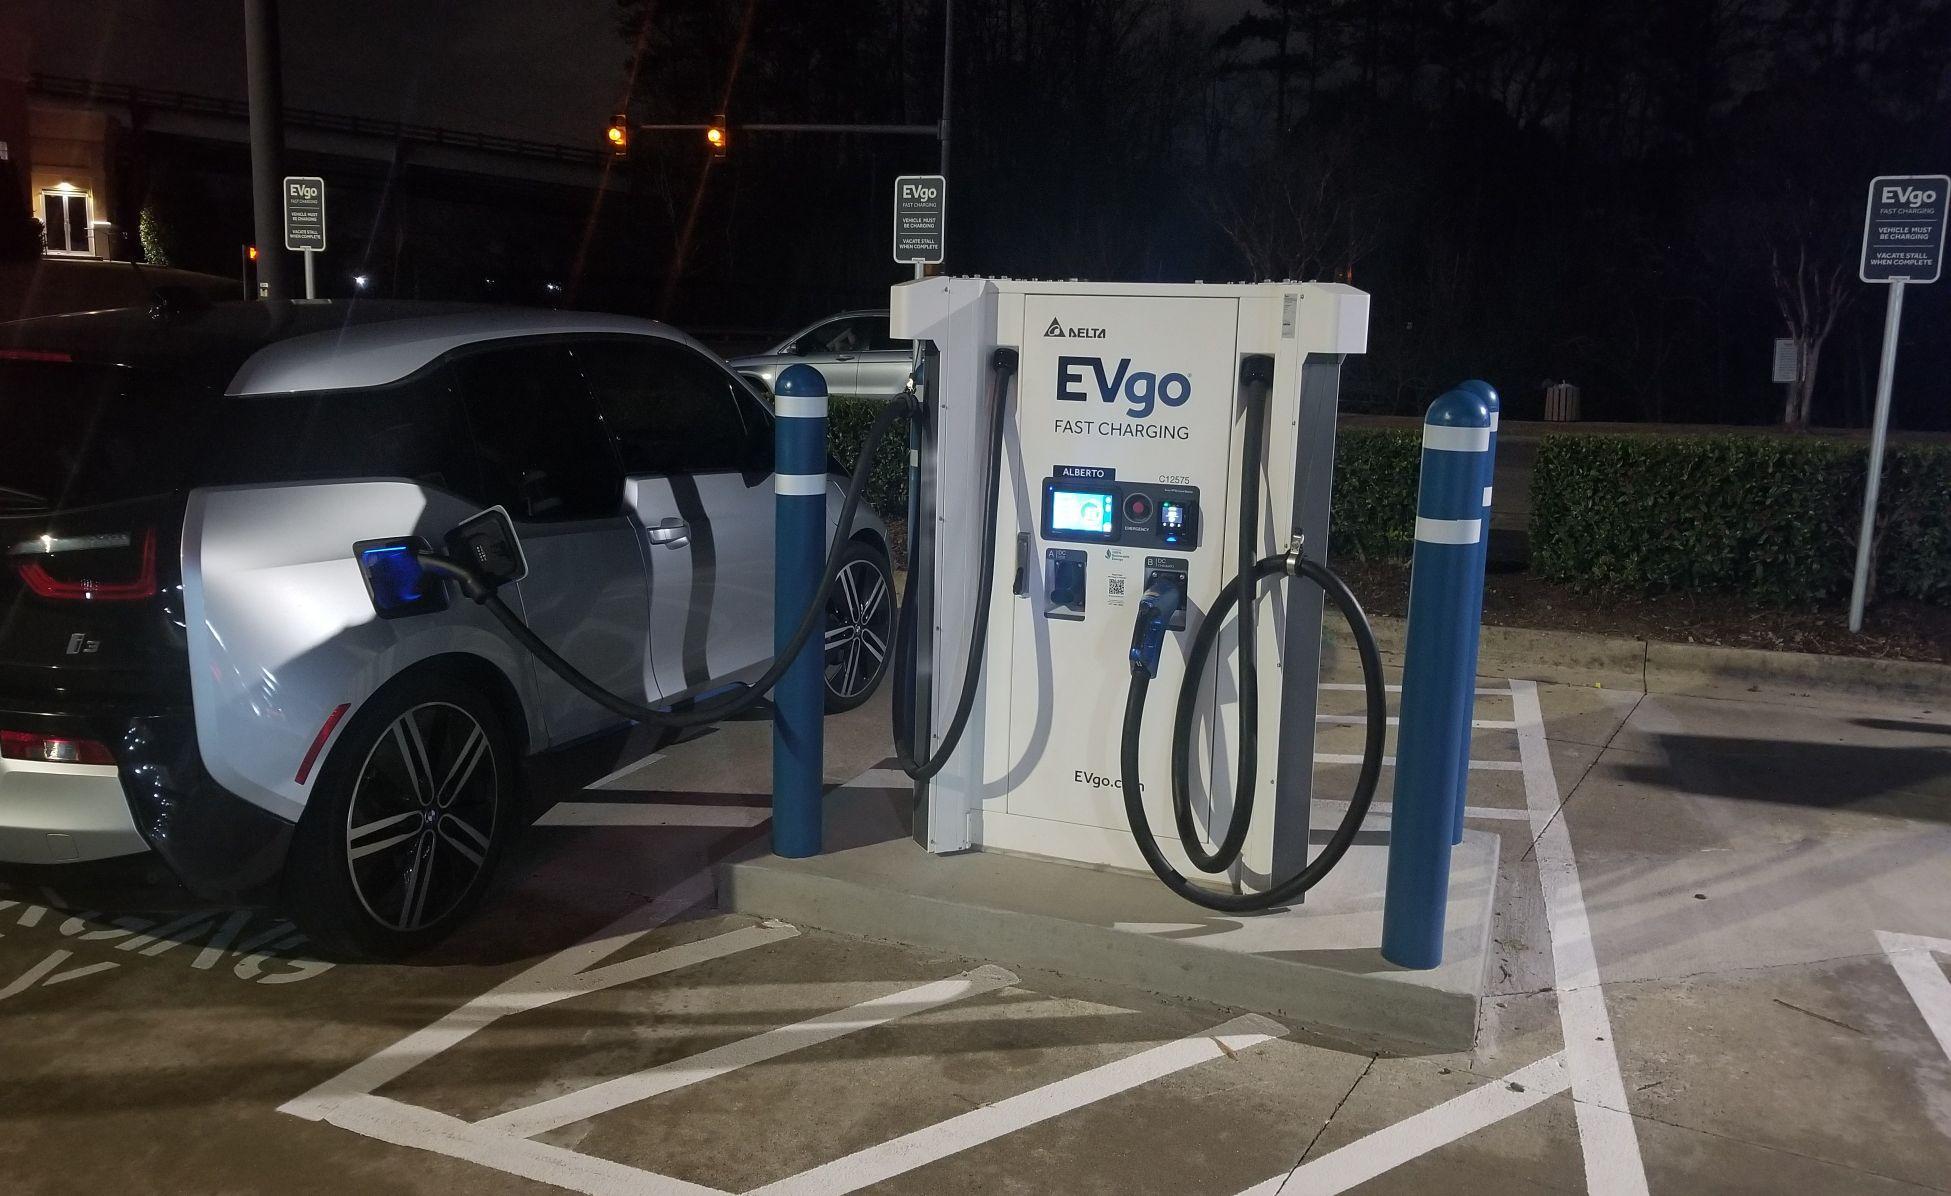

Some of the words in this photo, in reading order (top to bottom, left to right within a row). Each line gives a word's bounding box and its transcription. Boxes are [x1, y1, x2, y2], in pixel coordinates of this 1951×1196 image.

[290, 184, 318, 199] EVgo
[902, 184, 937, 202] EVgo
[1881, 186, 1937, 208] EVgo
[1068, 327, 1106, 339] DELTA
[1056, 355, 1192, 419] EVgo
[1054, 419, 1094, 435] FAST
[1098, 422, 1189, 440] CHARGING
[1062, 467, 1105, 478] ALBERTO
[1158, 475, 1190, 485] C12575
[1147, 558, 1154, 566] B
[1074, 770, 1145, 792] EVgo.c
